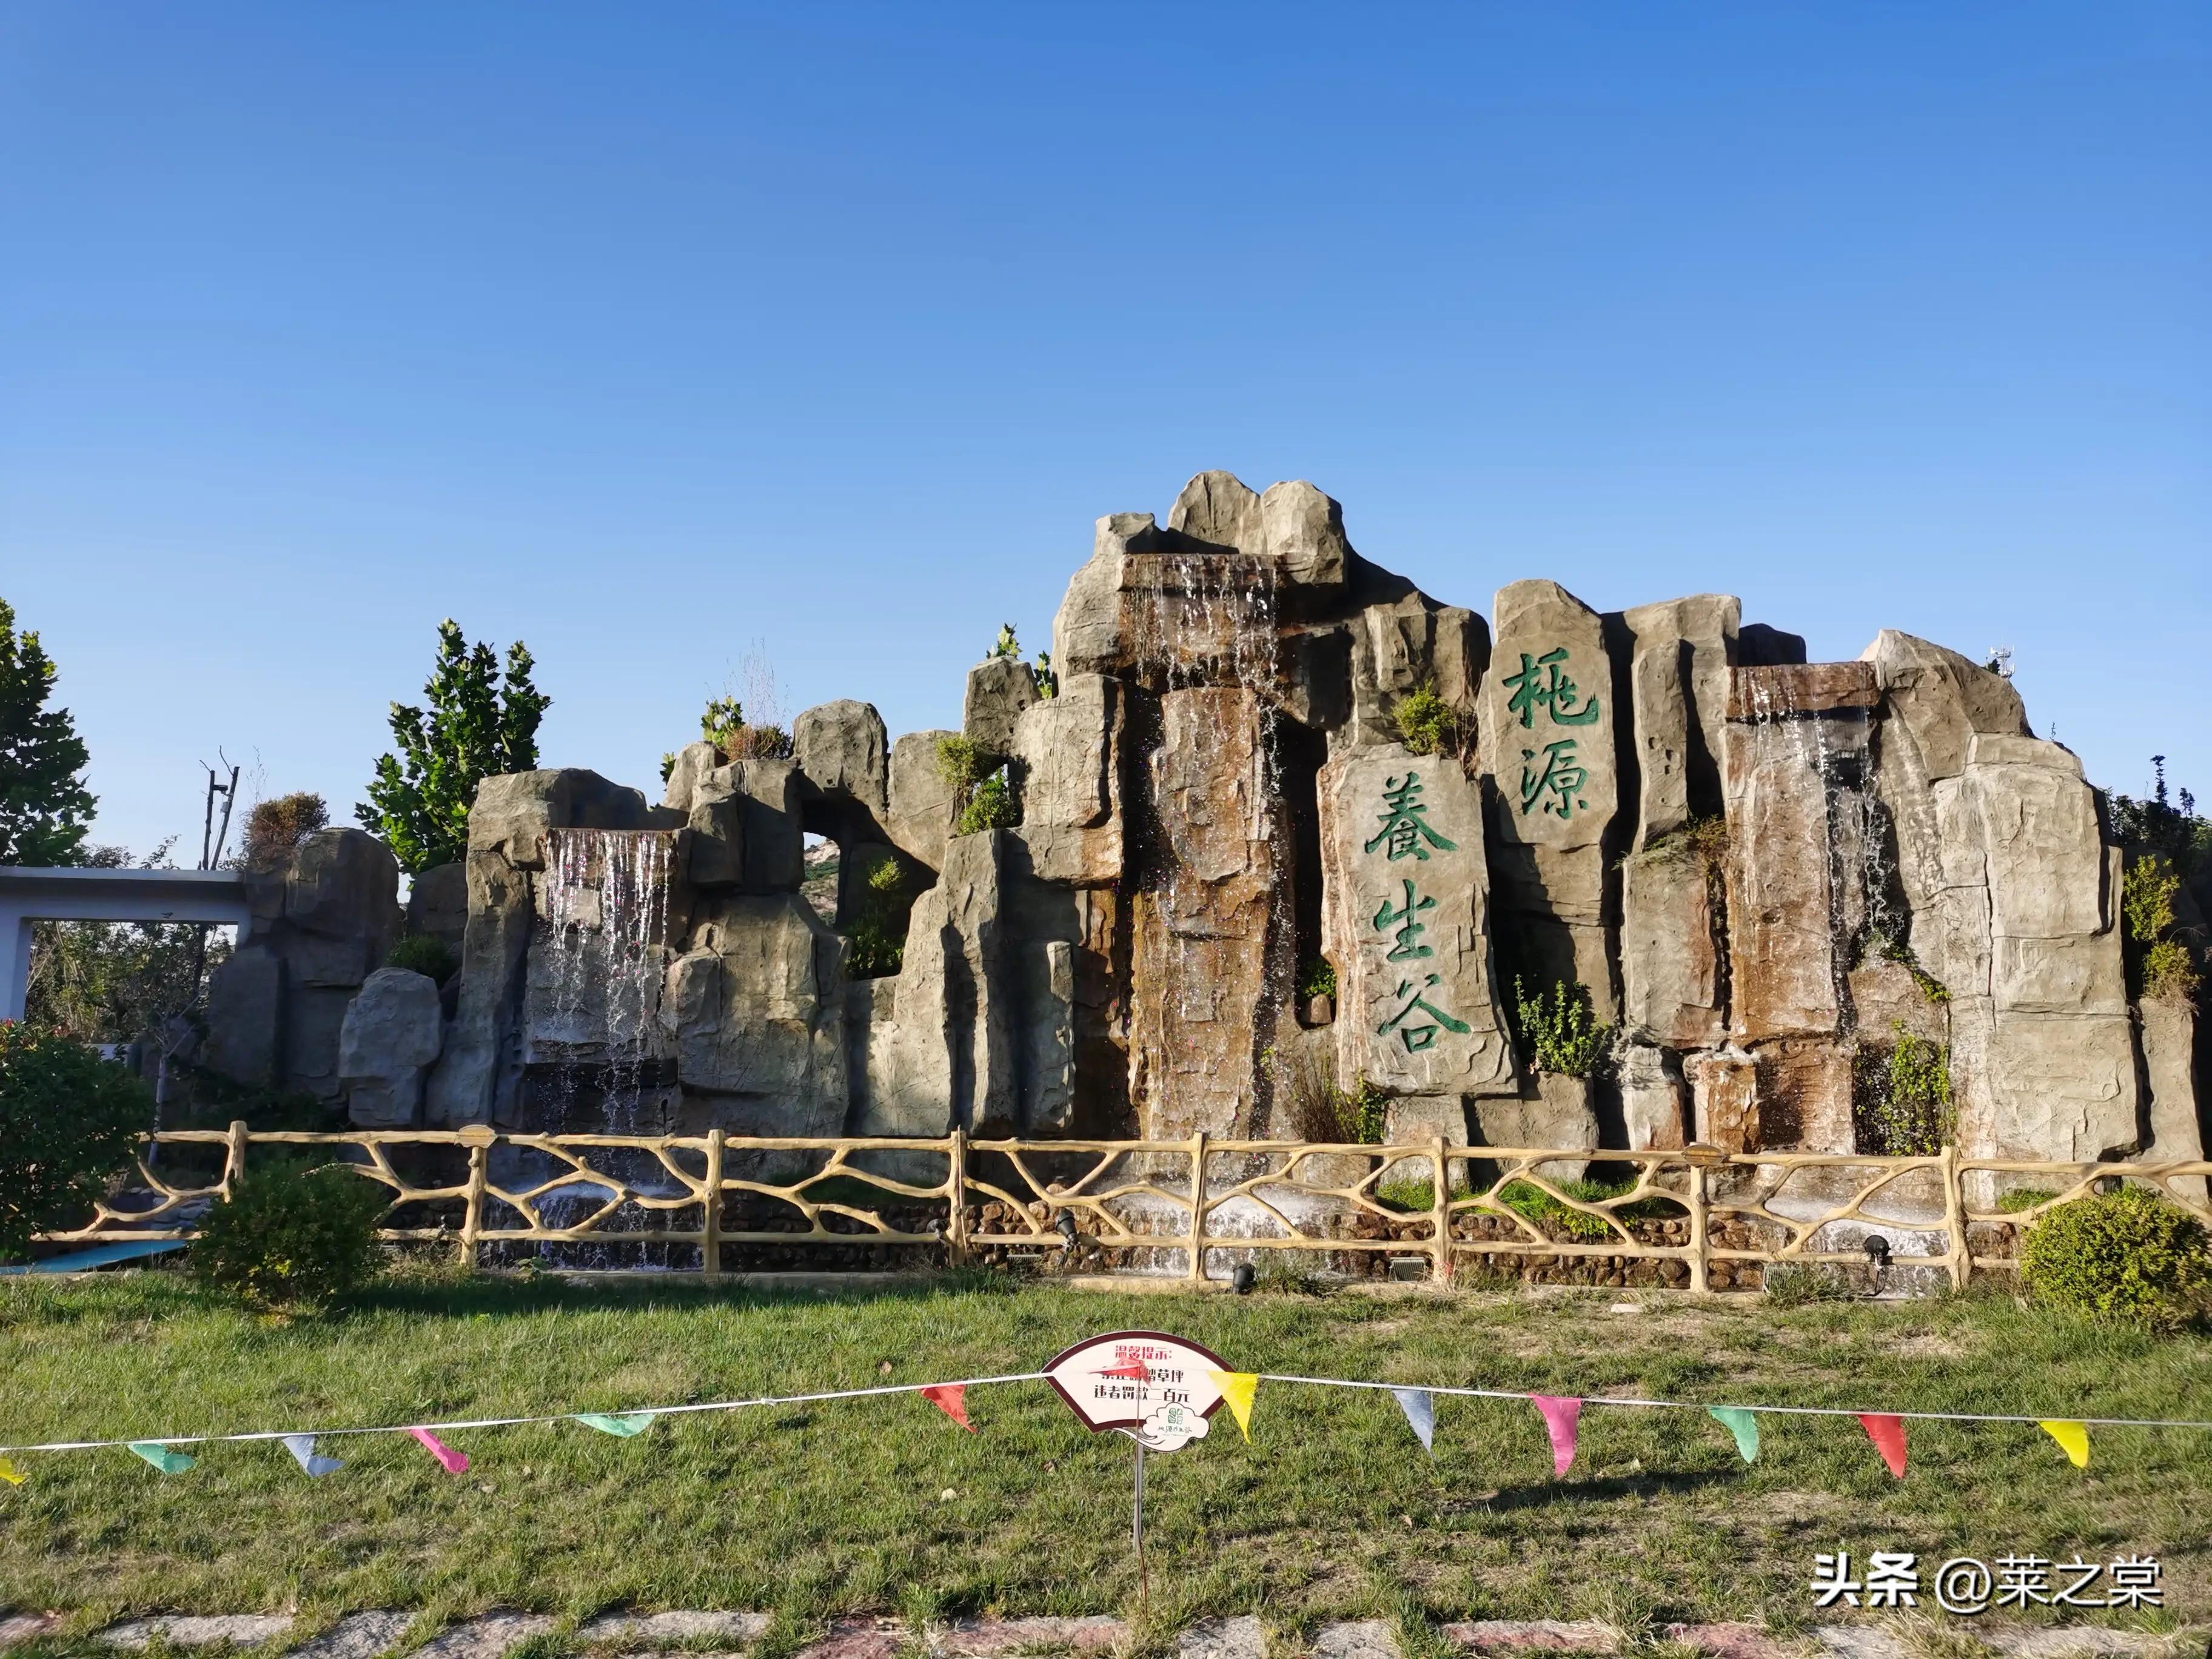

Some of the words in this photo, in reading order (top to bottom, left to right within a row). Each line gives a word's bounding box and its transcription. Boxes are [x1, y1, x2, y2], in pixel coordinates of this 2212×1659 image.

[1502, 647, 1600, 820] 桃源
[1365, 771, 1470, 1054] 養生谷
[1094, 1384, 1191, 1403] 违者罚款二百元
